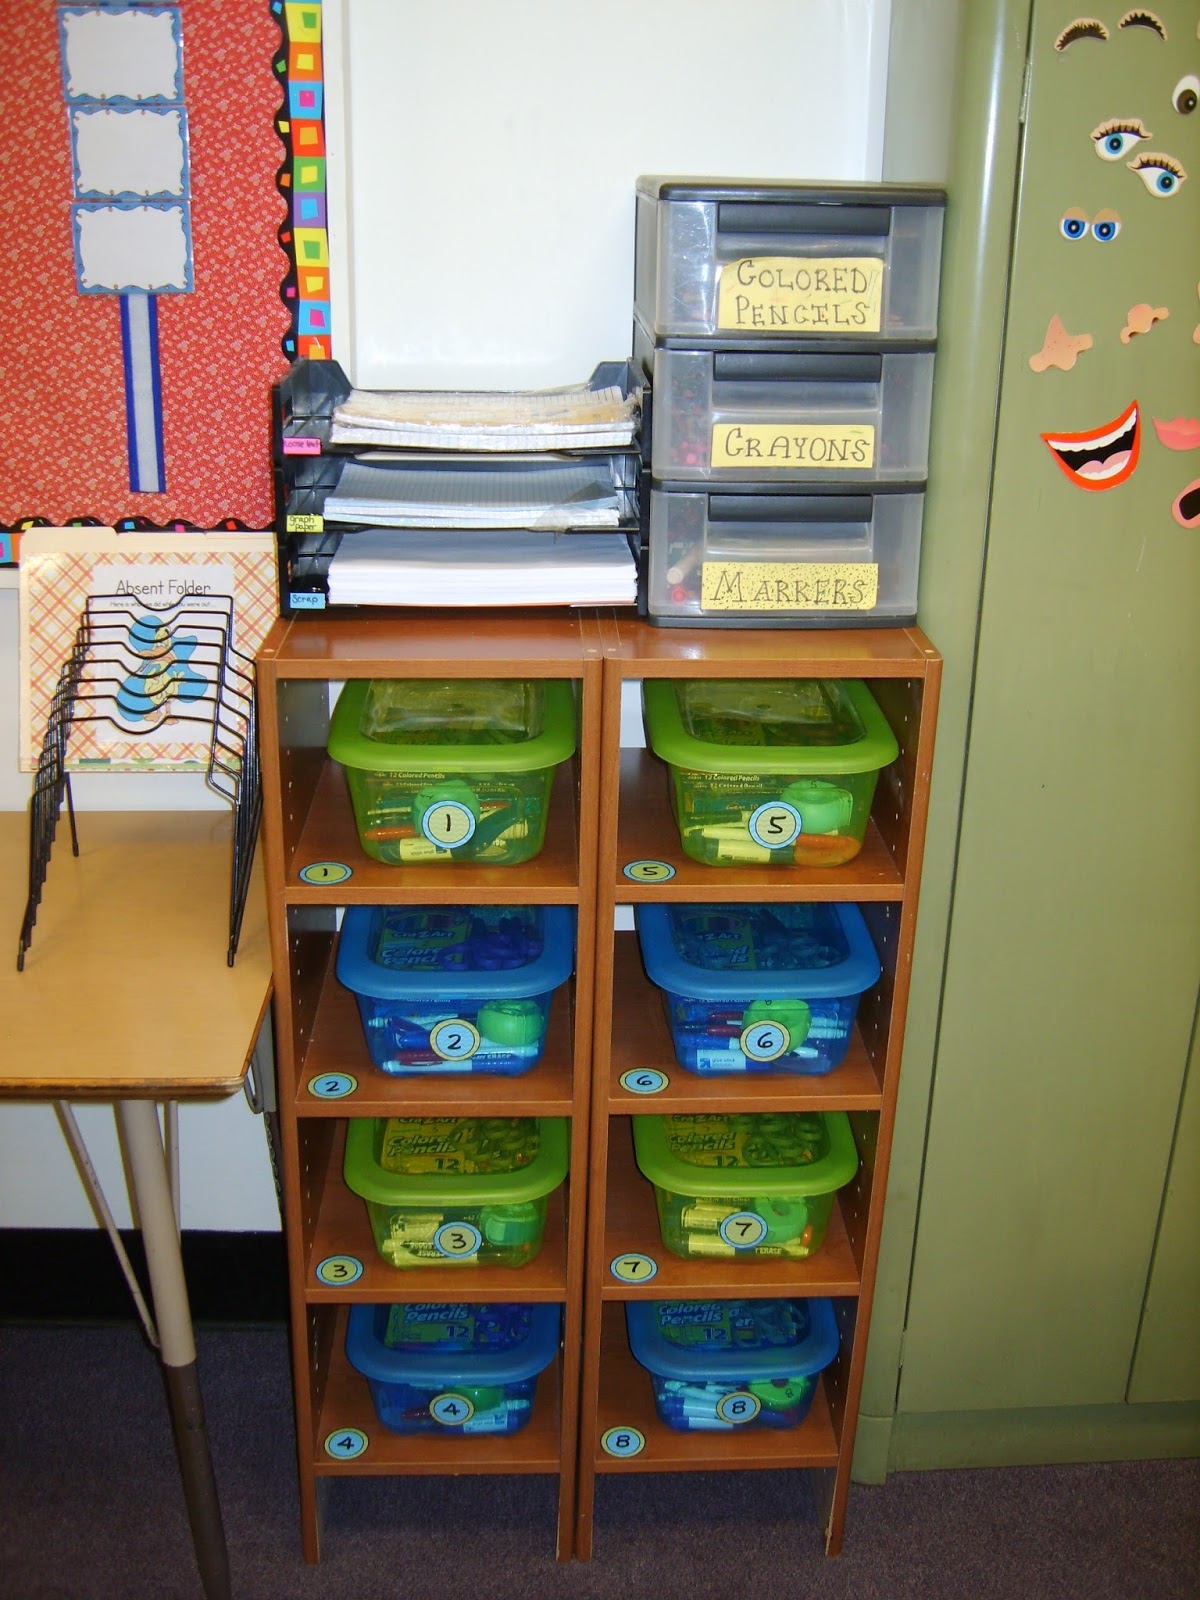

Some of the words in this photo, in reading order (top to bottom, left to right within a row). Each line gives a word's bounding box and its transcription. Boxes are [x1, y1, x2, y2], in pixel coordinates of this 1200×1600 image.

[736, 259, 868, 293] COLORED
[736, 295, 869, 326] PENCILS
[725, 427, 870, 462] CRAYONS
[289, 516, 315, 526] graph
[295, 523, 318, 532] paper
[116, 579, 164, 595] Absent
[168, 579, 211, 595] Folder
[709, 570, 868, 606] MARKERS
[292, 594, 319, 605] Scrap
[445, 813, 452, 833] 1
[767, 815, 787, 835] 5
[642, 866, 659, 876] 5
[446, 1034, 463, 1050] 2
[757, 1032, 774, 1049] 6
[325, 1080, 340, 1092] 2
[636, 1075, 653, 1087] 6
[435, 1157, 461, 1170] 12
[714, 1155, 739, 1167] 12
[735, 1221, 753, 1237] 7
[451, 1232, 467, 1250] 3
[333, 1264, 348, 1277] 3
[624, 1261, 642, 1273] 7
[660, 1311, 724, 1326] Pencils
[446, 1325, 471, 1338] 12
[703, 1327, 728, 1340] 12
[442, 1402, 461, 1416] 4
[731, 1401, 747, 1414] 8
[337, 1436, 355, 1450] 4
[615, 1435, 631, 1448] 8
